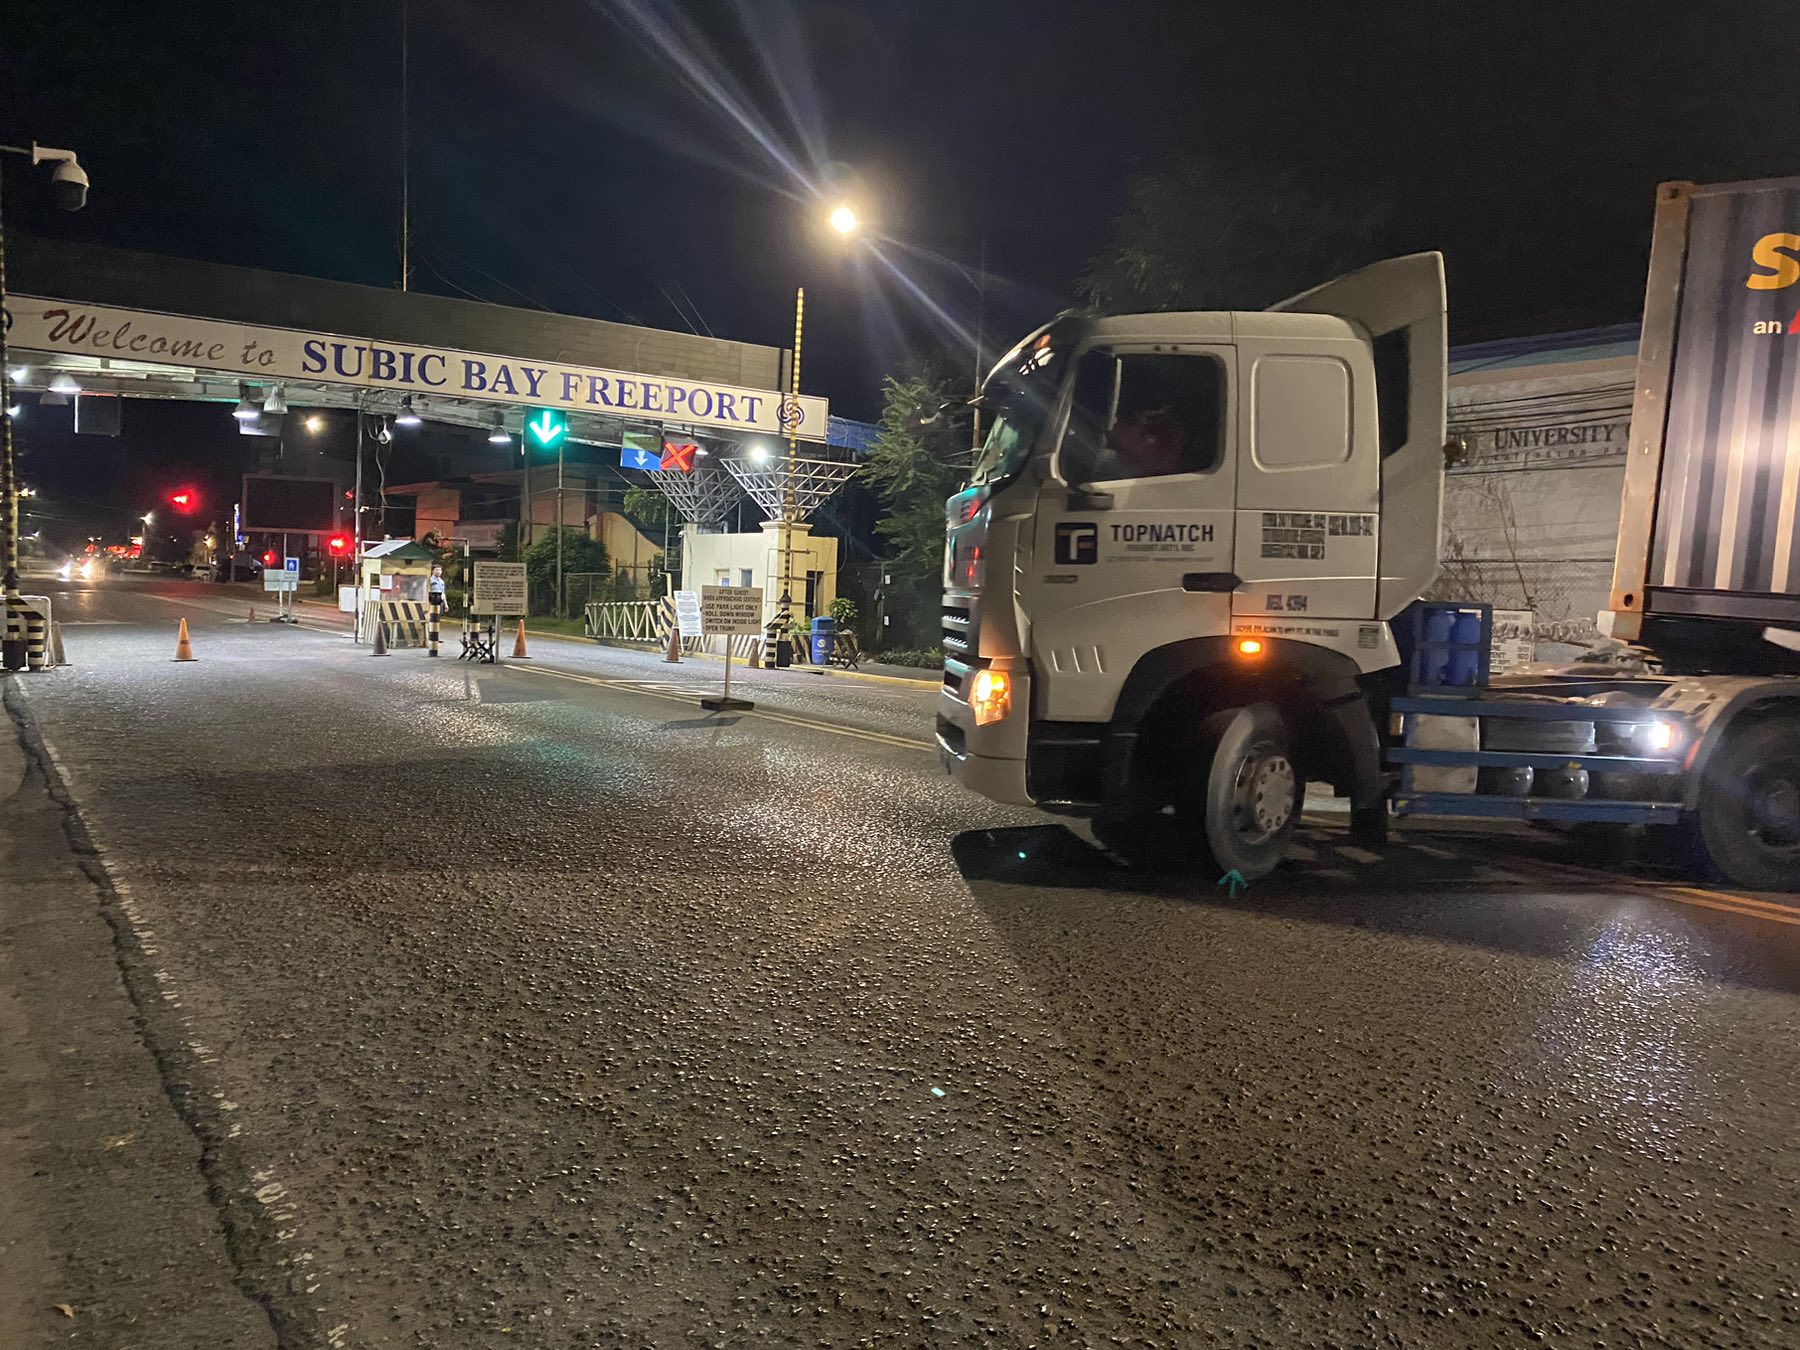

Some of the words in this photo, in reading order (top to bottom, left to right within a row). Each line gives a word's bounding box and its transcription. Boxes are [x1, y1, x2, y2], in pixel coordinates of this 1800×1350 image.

[1753, 320, 1782, 334] an
[42, 309, 225, 360] Welcome
[240, 340, 275, 367] to
[302, 339, 447, 386] SUBIC
[461, 359, 548, 397] BAY
[560, 371, 763, 424] FREEPORT
[1110, 524, 1214, 542] TOPNATCH
